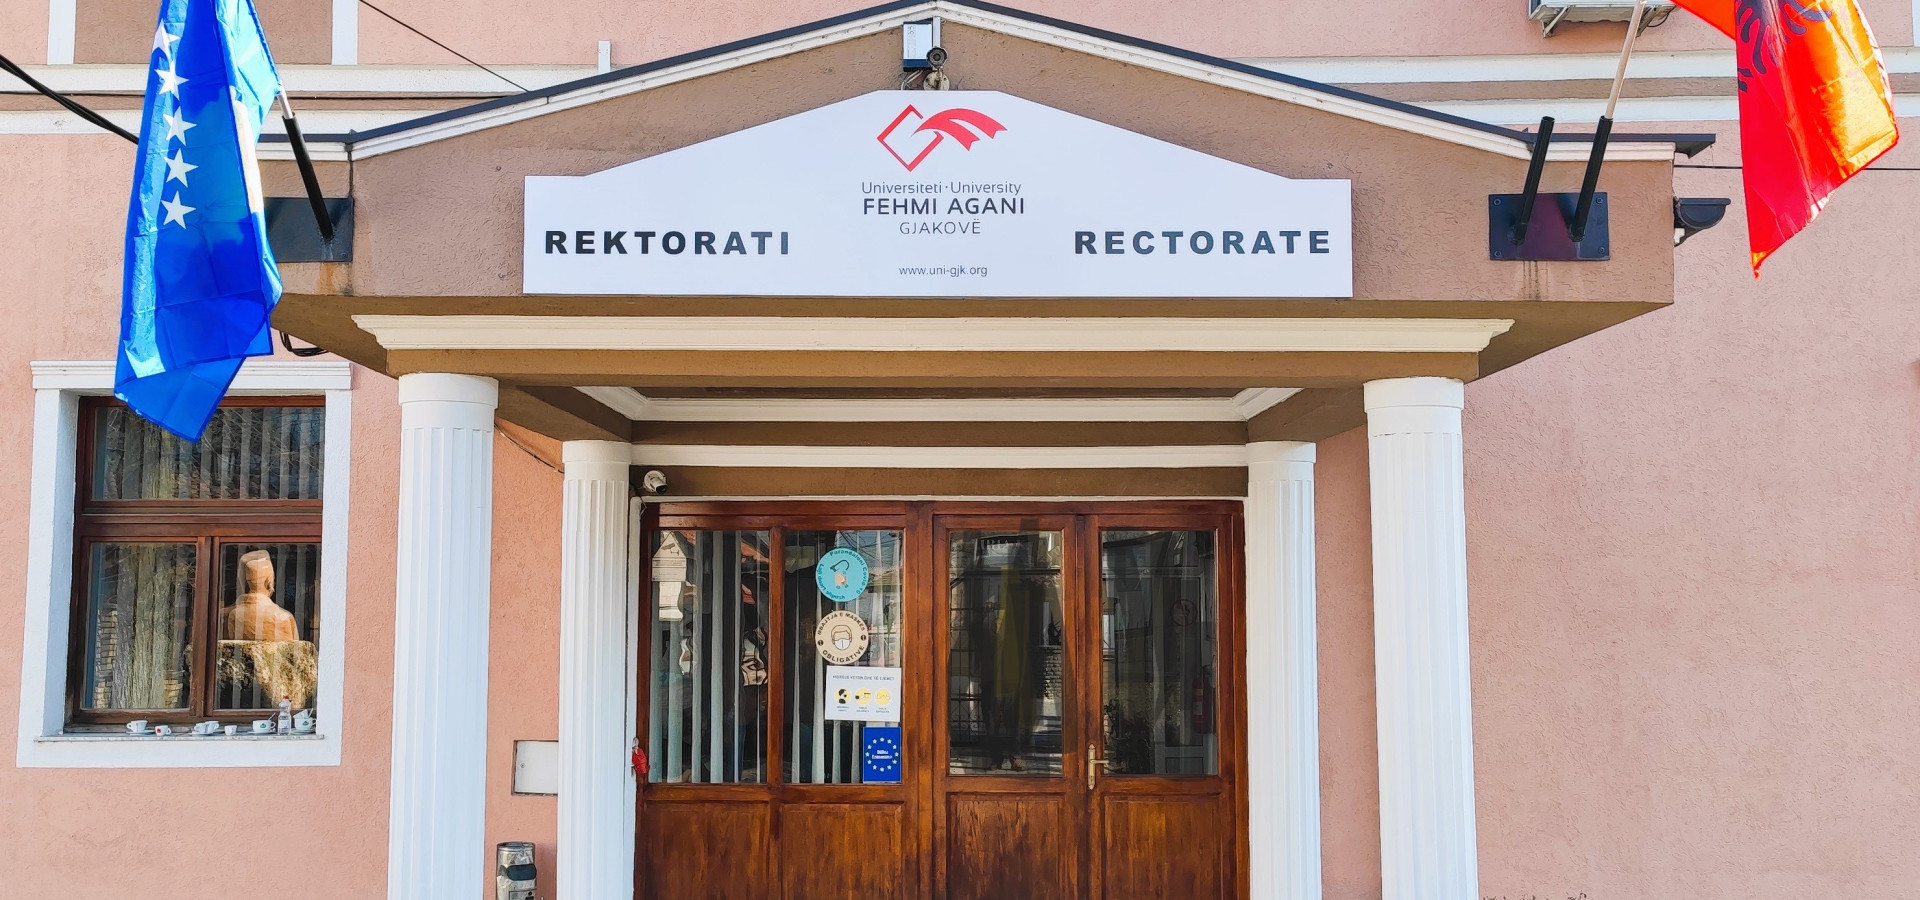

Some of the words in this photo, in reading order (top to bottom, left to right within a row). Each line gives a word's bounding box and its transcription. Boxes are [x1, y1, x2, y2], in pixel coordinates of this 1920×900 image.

[861, 181, 942, 194] Universiteti
[950, 181, 1022, 196] University
[863, 198, 937, 215] FEHMI
[947, 197, 1025, 215] AGANI
[899, 218, 981, 235] GJAKOVË
[545, 230, 789, 255] REKTORATI
[1074, 230, 1330, 255] RECTORATE
[898, 265, 988, 277] www.uni-gjk.org
[822, 644, 865, 663] OBLIGATIVE
